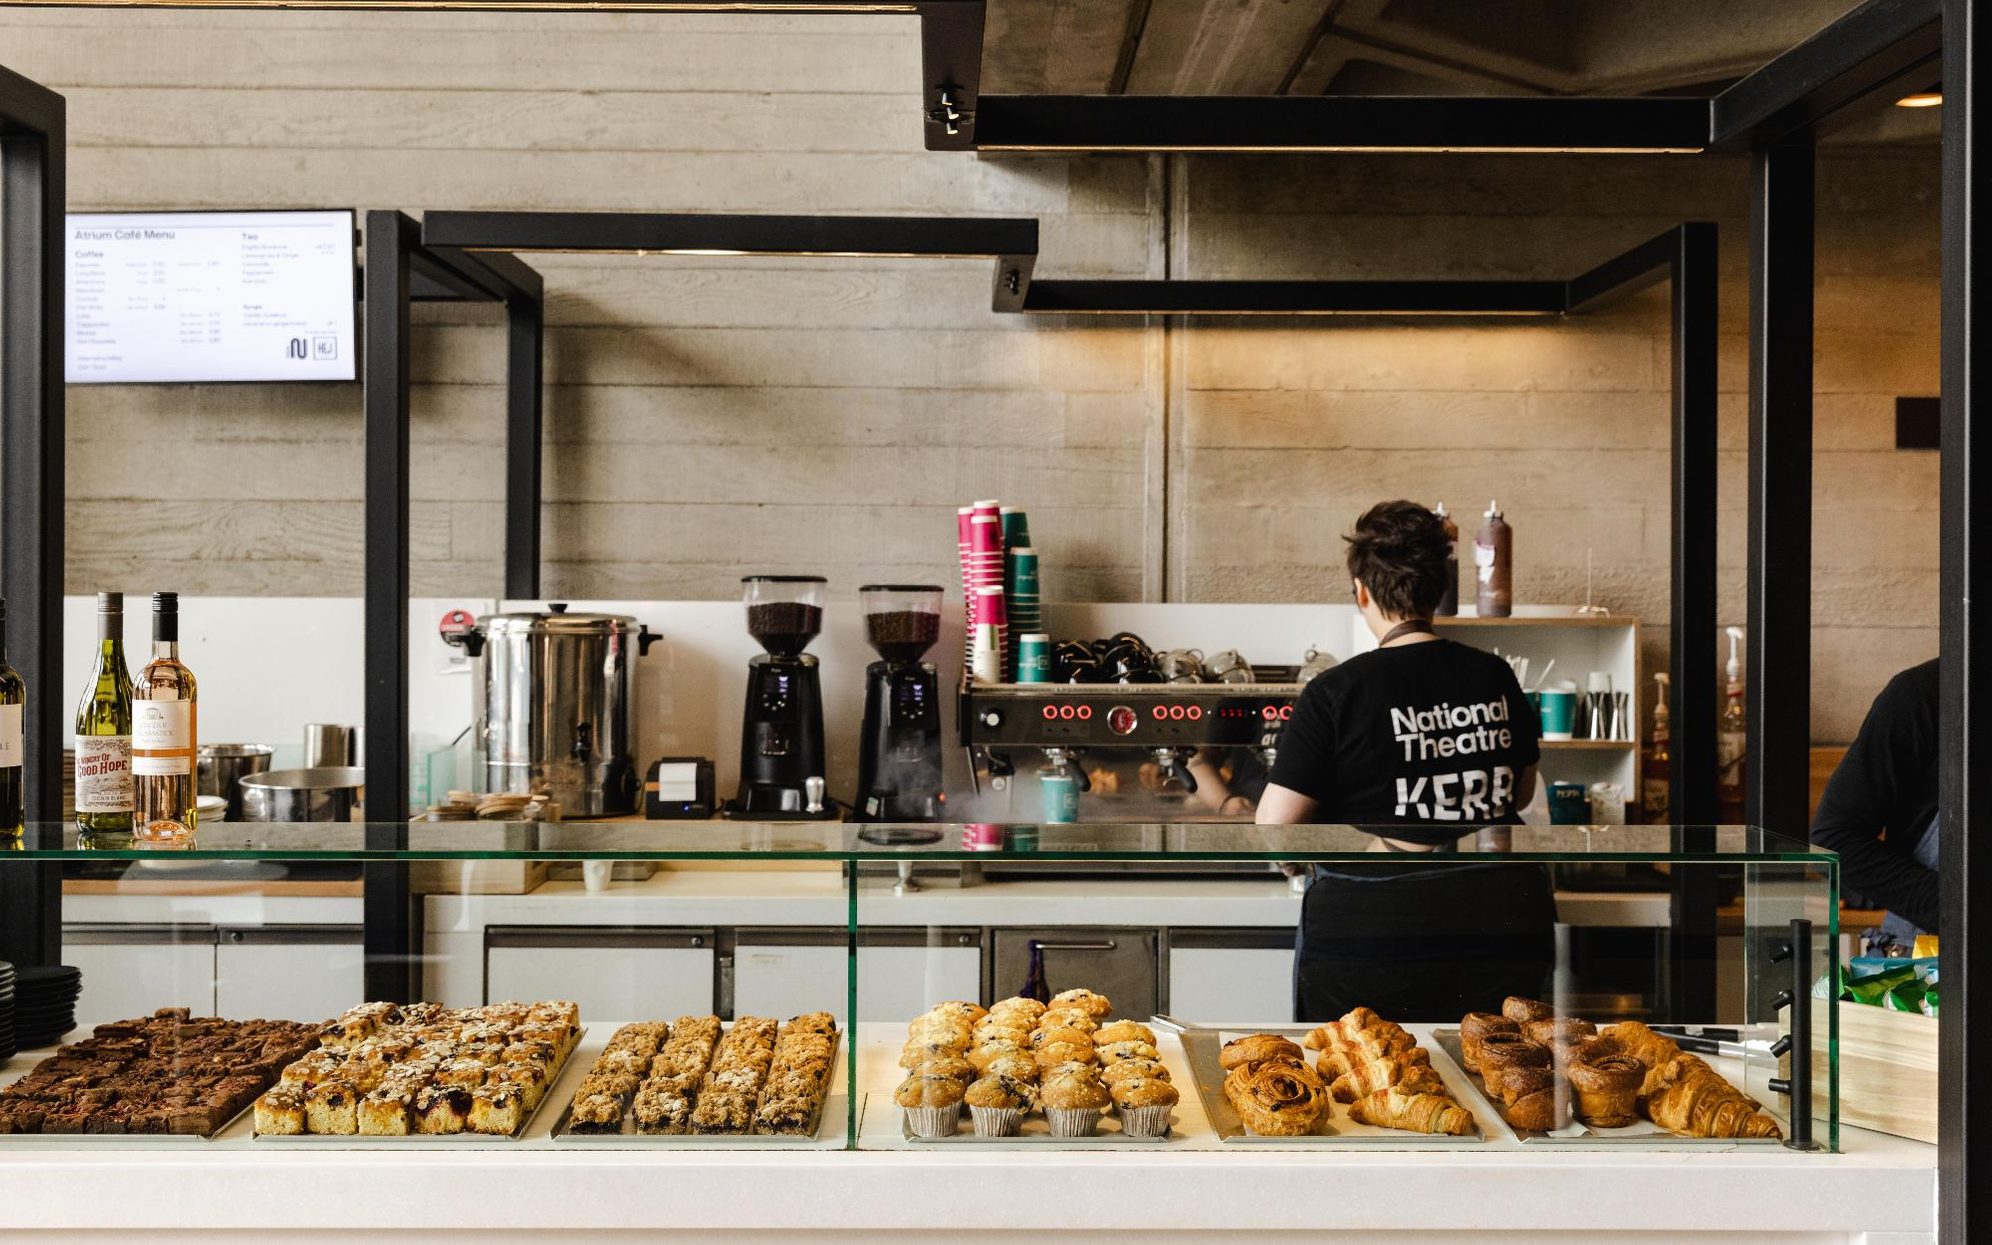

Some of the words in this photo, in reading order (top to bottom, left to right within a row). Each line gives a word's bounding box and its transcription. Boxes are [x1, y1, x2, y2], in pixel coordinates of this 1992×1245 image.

[75, 230, 112, 240] Atrium
[115, 230, 142, 240] Café
[144, 229, 176, 239] Menu
[75, 250, 104, 259] Coffee
[1390, 694, 1510, 735] National
[1395, 726, 1513, 762] Theatre
[81, 755, 101, 765] WINERY
[77, 764, 98, 778] GOOD
[100, 759, 128, 775] HOPE
